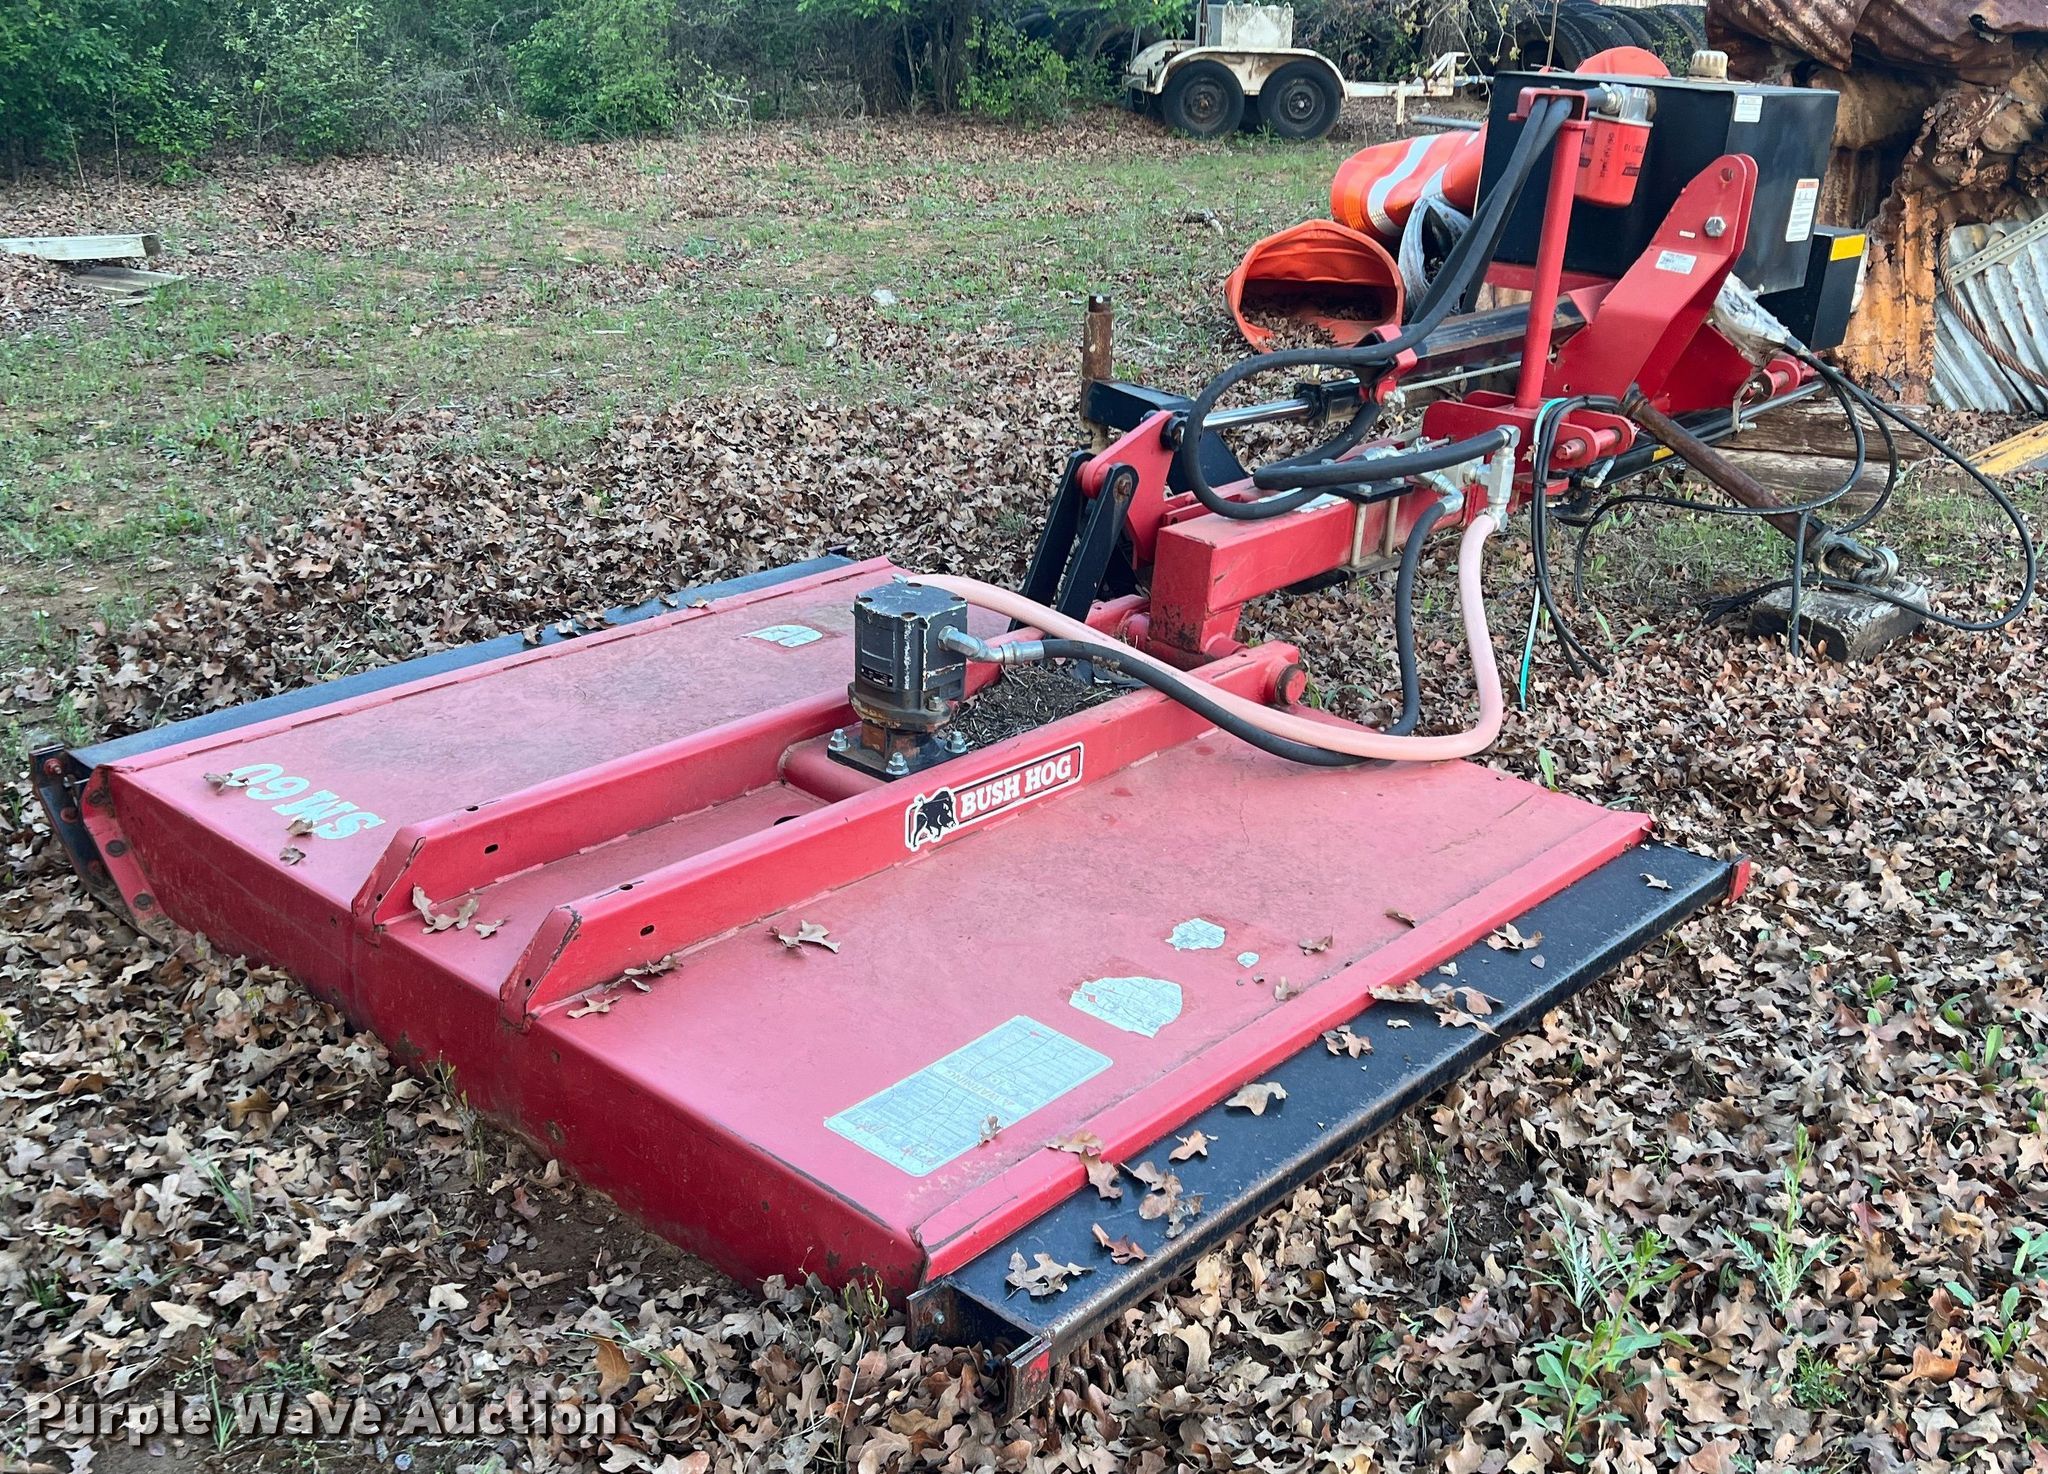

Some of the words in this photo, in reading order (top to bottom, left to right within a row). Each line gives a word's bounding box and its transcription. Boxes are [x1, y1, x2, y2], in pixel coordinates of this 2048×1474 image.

[225, 763, 386, 840] SM60
[960, 772, 1021, 818] BUSH
[1025, 755, 1072, 793] HOG
[945, 1071, 1000, 1102] WARNING
